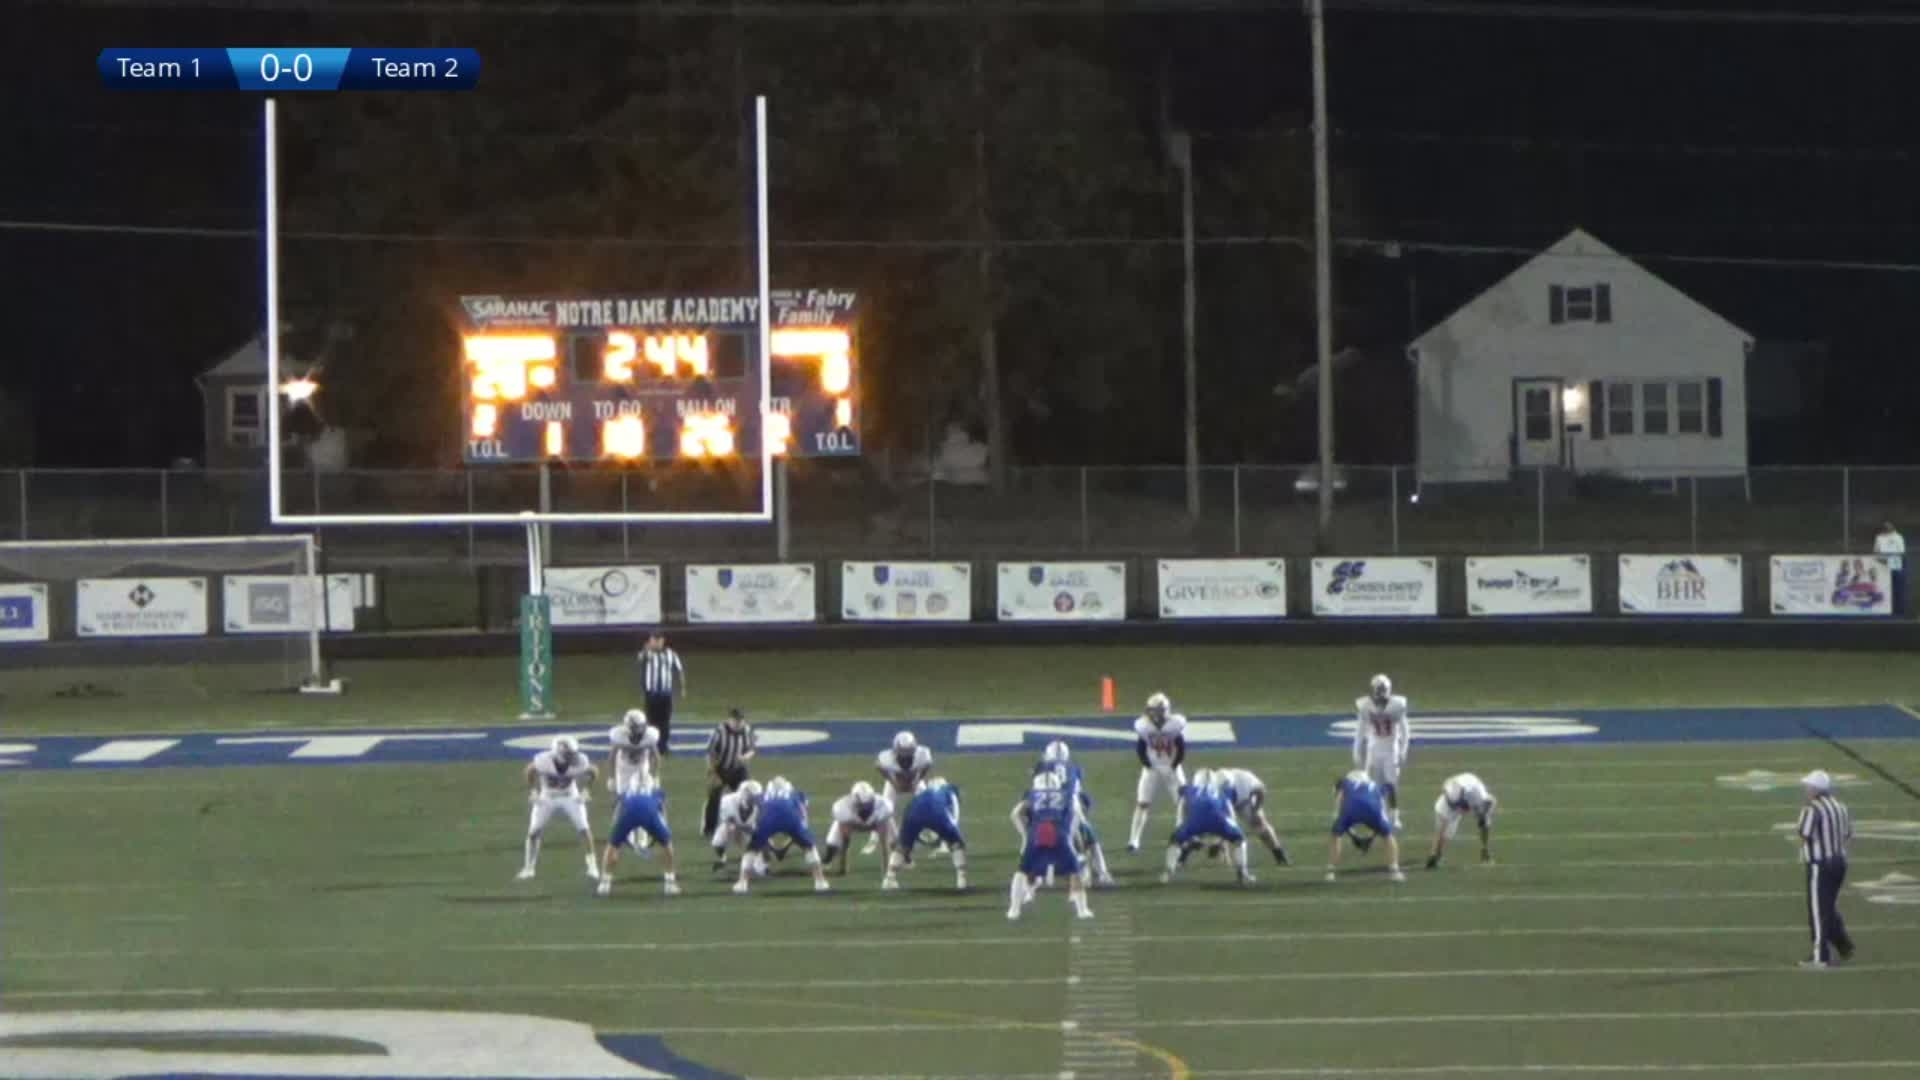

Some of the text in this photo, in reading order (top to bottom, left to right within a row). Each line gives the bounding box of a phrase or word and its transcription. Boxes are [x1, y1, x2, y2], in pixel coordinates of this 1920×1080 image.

[472, 299, 551, 318] SARANAC
[807, 288, 856, 310] Fabry
[555, 300, 614, 327] NOTRE
[617, 298, 668, 326] DAME
[672, 297, 760, 325] ACADEMY
[778, 306, 836, 326] Family
[521, 400, 572, 421] DOWN
[592, 400, 642, 419] TO GO
[675, 397, 736, 417] BALL ON
[759, 396, 792, 416] TR
[1656, 577, 1707, 601] BHR
